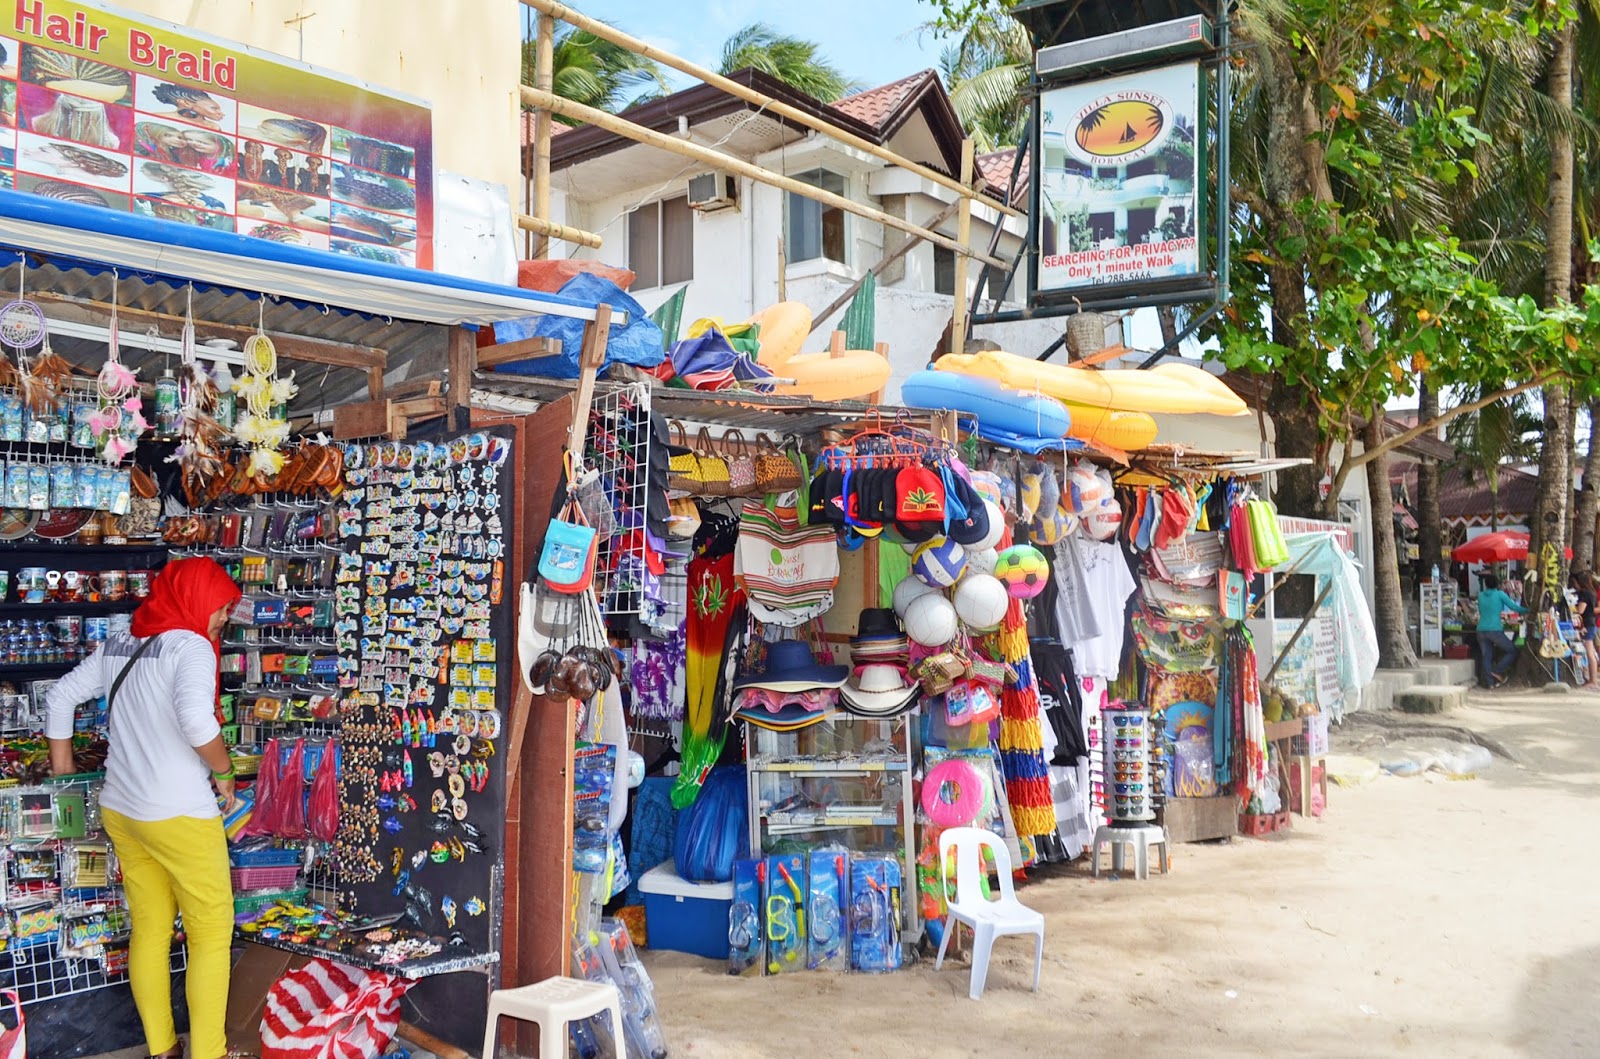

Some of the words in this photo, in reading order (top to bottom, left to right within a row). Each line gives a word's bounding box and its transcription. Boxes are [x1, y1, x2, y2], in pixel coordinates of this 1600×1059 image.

[15, 0, 107, 53] Hair
[128, 28, 237, 91] Braid
[1076, 95, 1111, 120] VILLA
[1117, 91, 1165, 108] SUNSET
[1090, 147, 1147, 164] BORACAY
[1044, 251, 1105, 268] SEARCHING
[1109, 247, 1131, 260] FOR
[1134, 238, 1195, 256] PRIVACY??
[1068, 266, 1092, 278] Only
[1096, 263, 1101, 275] 1
[1105, 259, 1143, 273] minute
[1146, 255, 1174, 268] Walk
[1108, 270, 1152, 283] 288-5666
